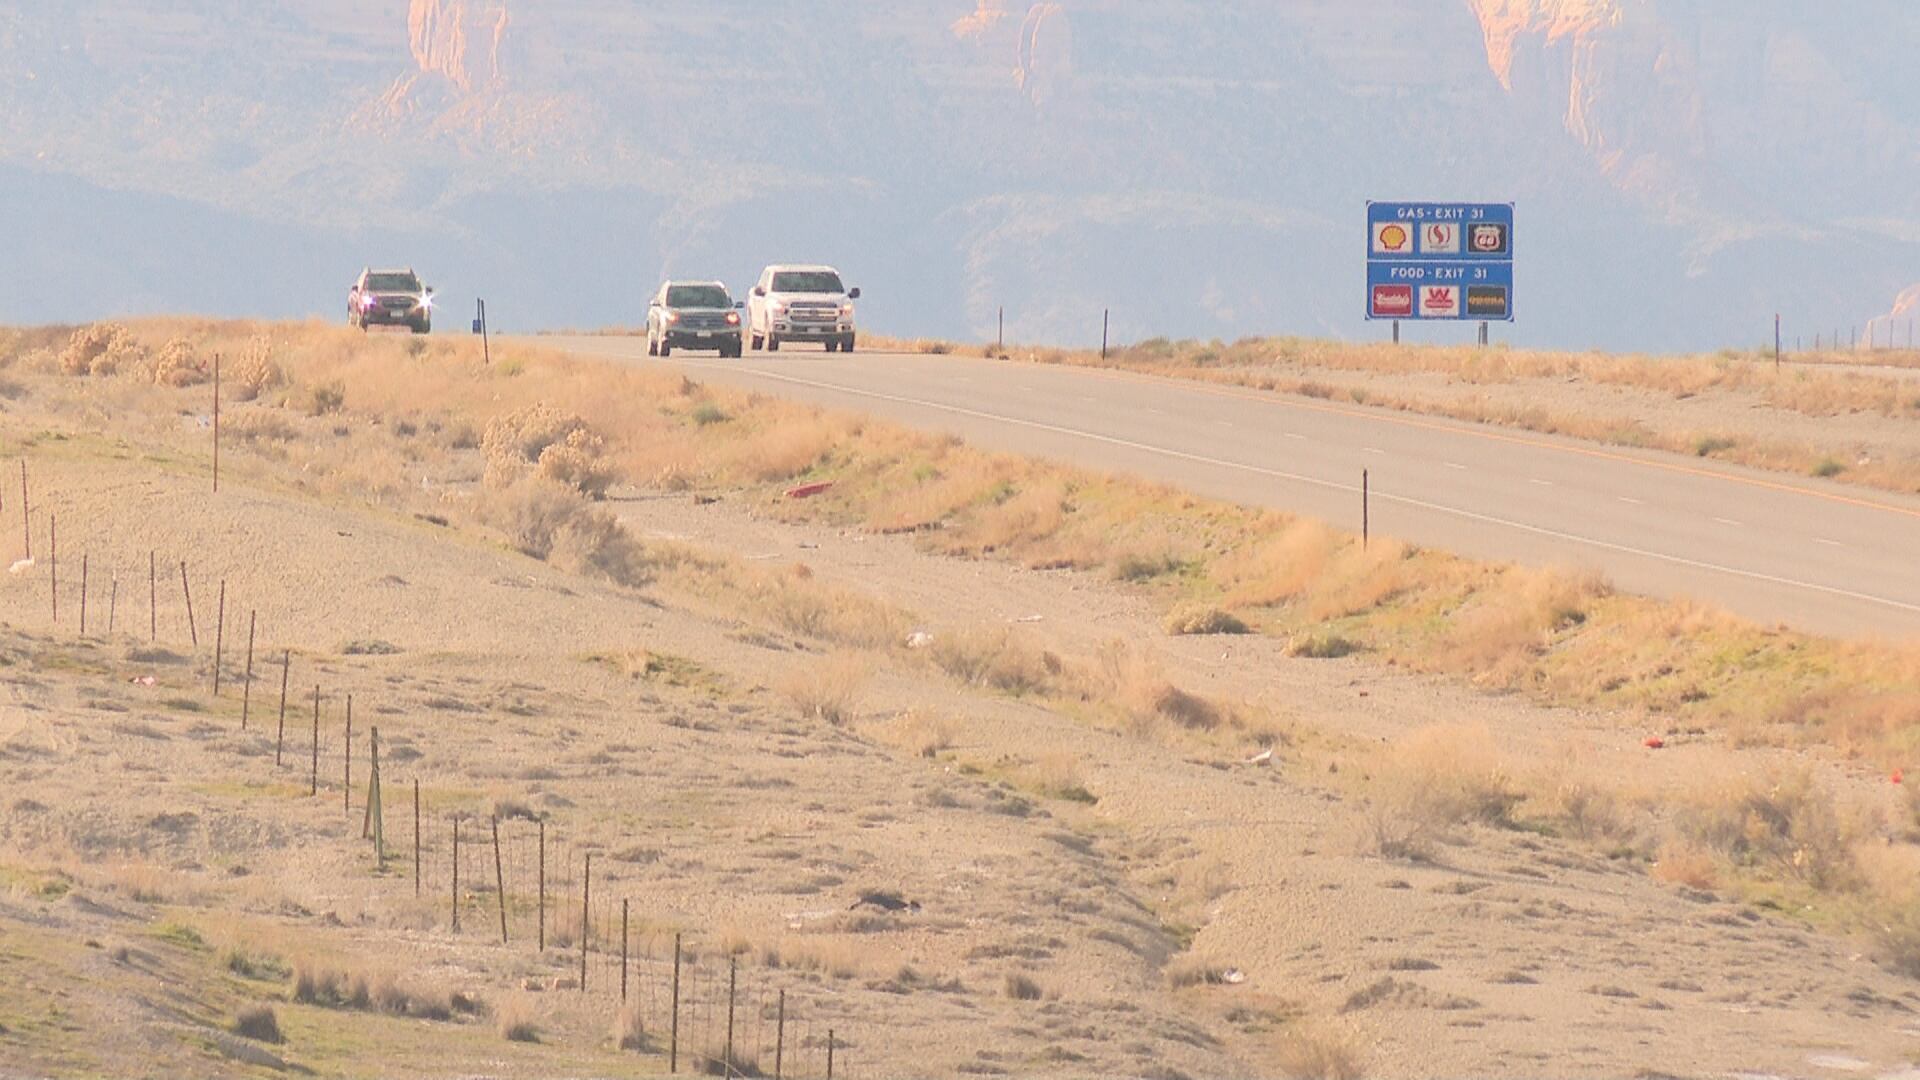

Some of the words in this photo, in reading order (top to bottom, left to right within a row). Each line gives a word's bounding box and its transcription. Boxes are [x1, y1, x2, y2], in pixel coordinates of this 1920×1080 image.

[1397, 207, 1425, 219] GAS
[1435, 207, 1465, 219] EXIT
[1471, 207, 1484, 219] 31
[1391, 267, 1425, 279] FOOD
[1435, 267, 1465, 279] EXIT
[1474, 267, 1488, 279] 31
